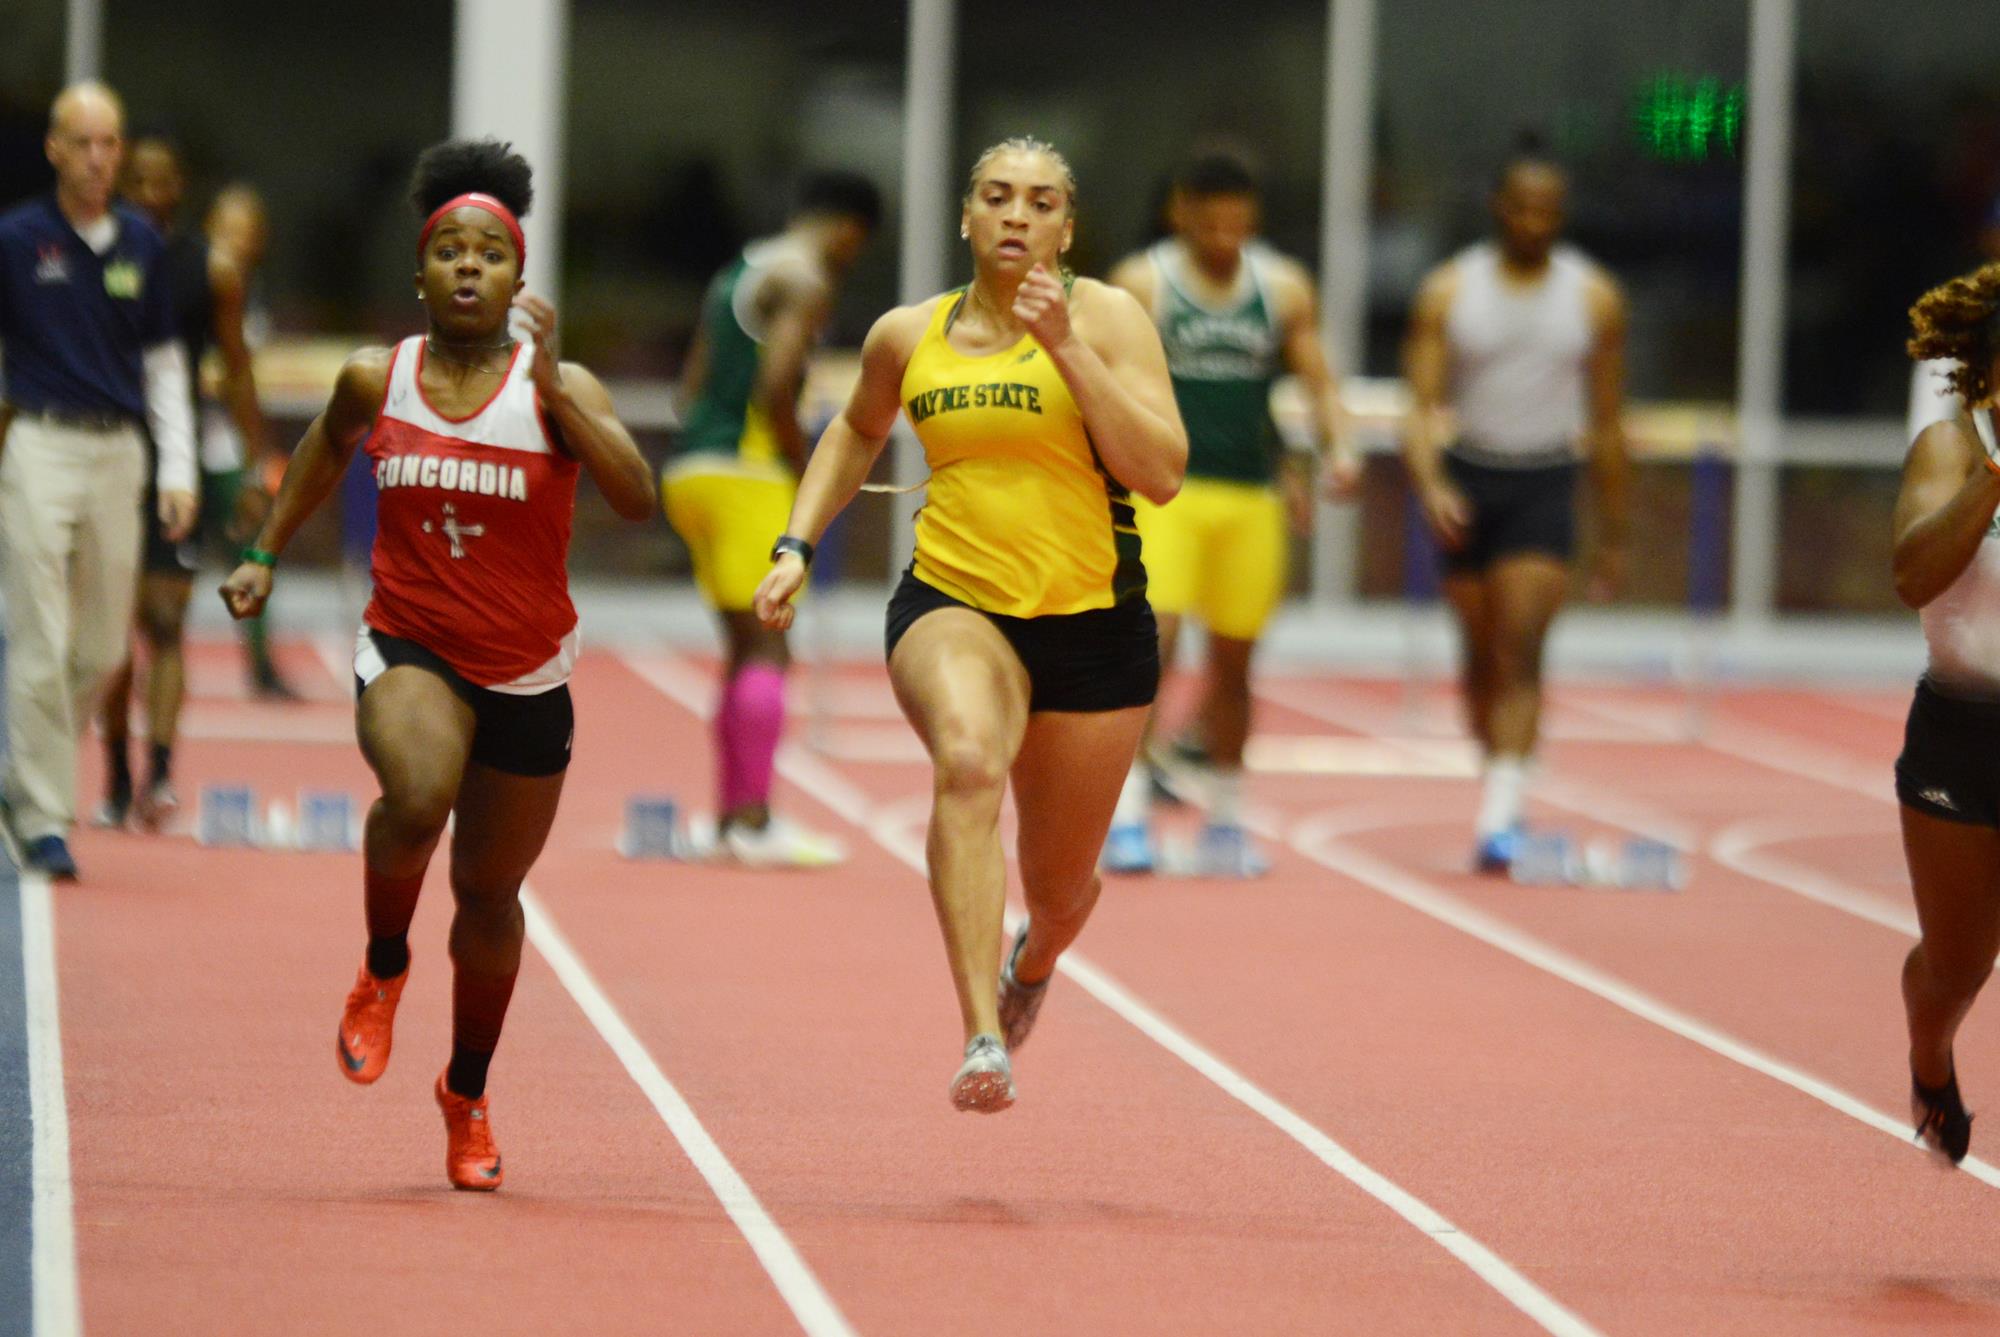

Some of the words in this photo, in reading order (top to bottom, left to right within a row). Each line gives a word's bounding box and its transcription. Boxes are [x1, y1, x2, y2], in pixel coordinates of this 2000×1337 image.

[909, 385, 970, 423] WAYNE
[975, 382, 1042, 414] STATE
[376, 454, 527, 502] CONCORDIA
